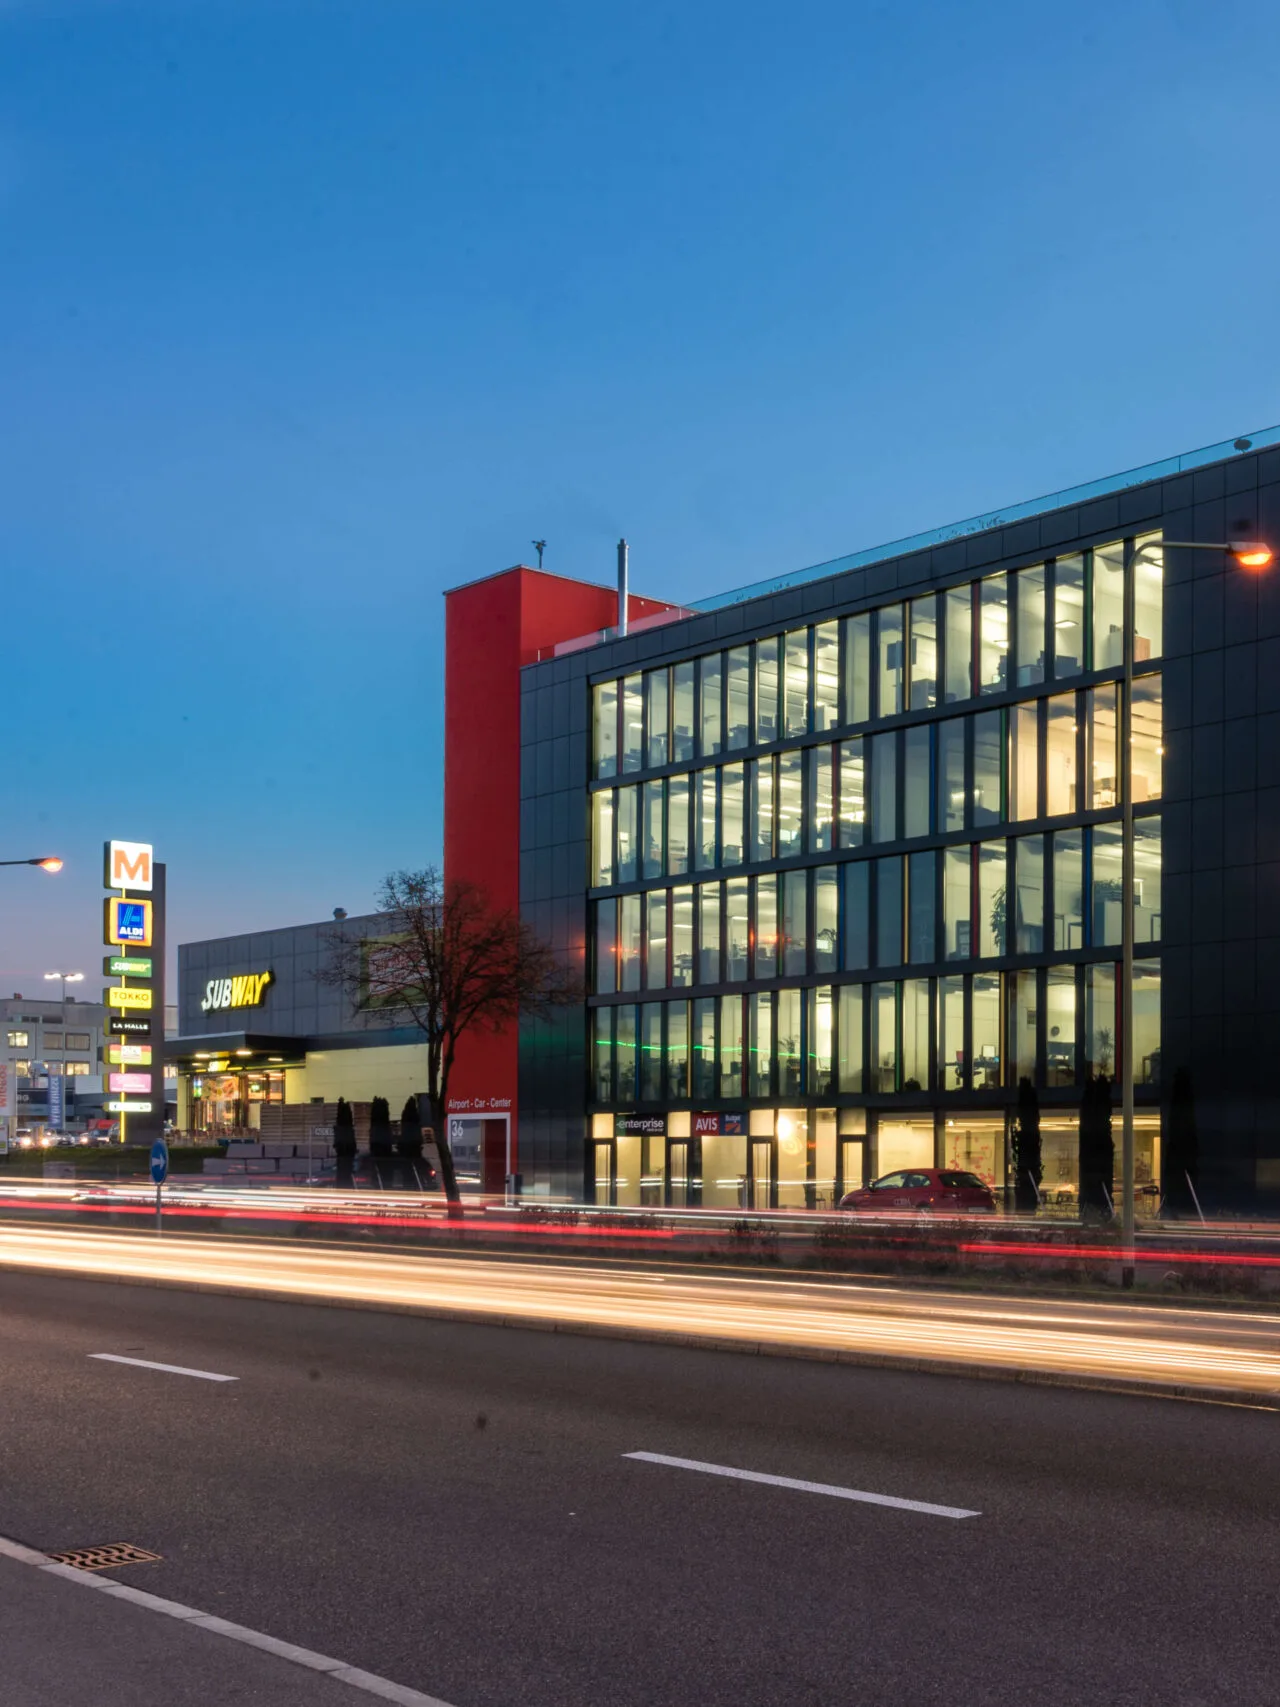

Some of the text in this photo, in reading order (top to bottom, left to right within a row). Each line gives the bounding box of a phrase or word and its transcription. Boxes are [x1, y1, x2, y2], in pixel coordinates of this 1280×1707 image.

[114, 849, 150, 882] M
[119, 926, 143, 936] ALDI
[201, 970, 271, 1011] SUBWAY
[448, 1098, 470, 1110] Airport
[474, 1097, 485, 1108] Car
[490, 1097, 511, 1108] Center
[452, 1120, 464, 1137] 36
[616, 1117, 664, 1131] enterprise
[696, 1117, 717, 1131] AVIS
